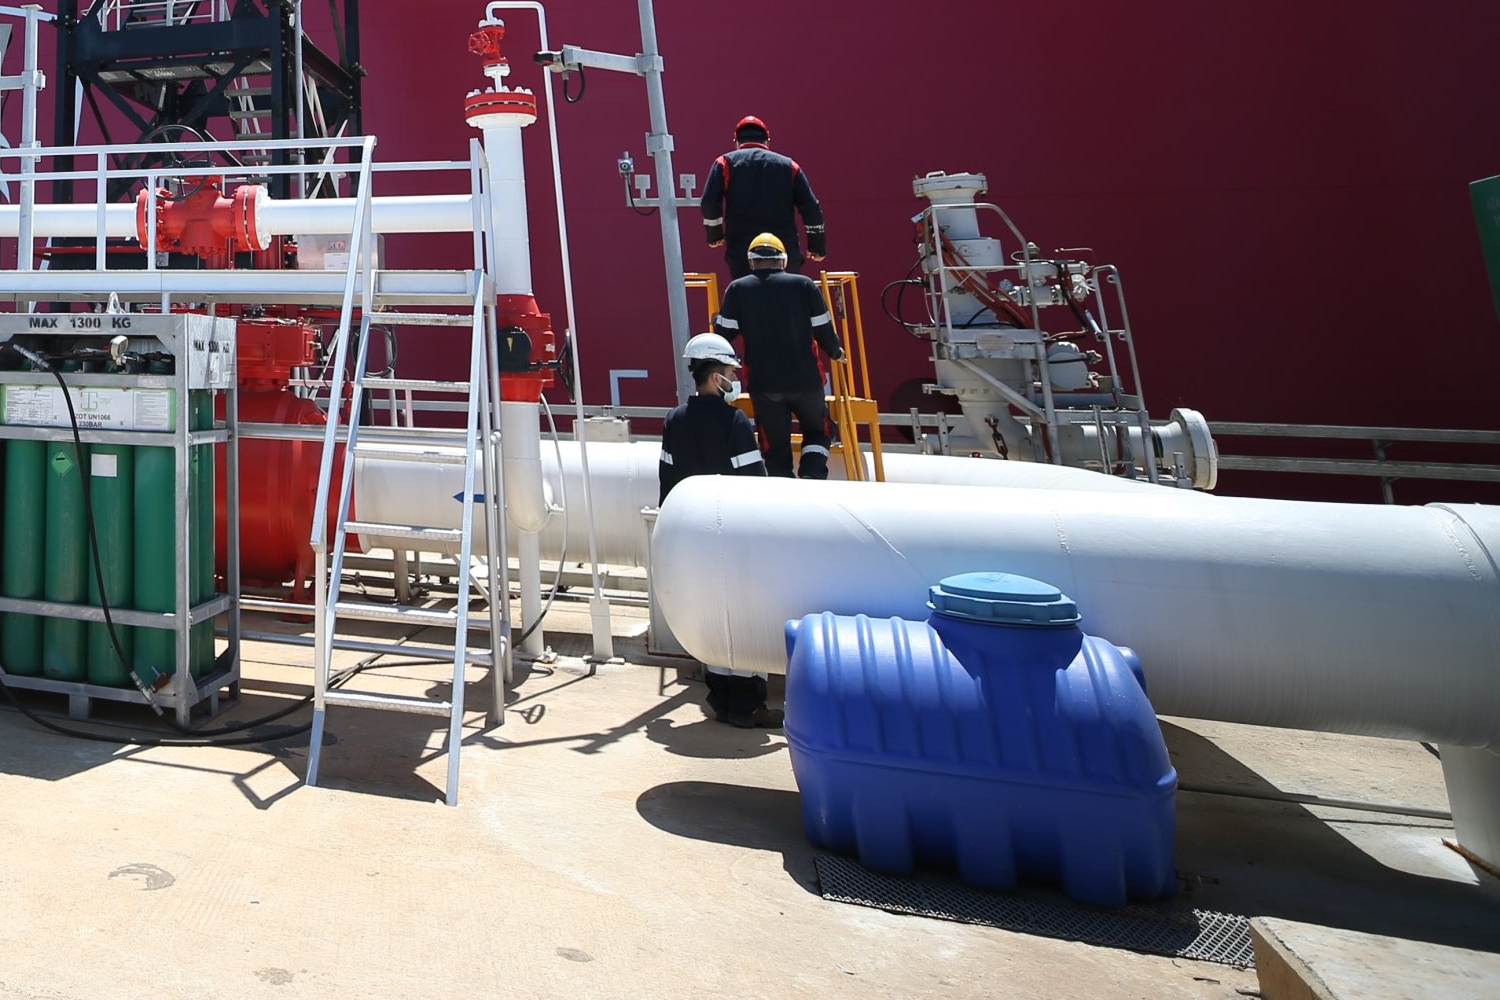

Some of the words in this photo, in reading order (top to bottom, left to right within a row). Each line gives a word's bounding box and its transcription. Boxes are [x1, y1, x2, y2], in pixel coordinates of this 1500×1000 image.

[29, 317, 58, 329] MAX
[69, 317, 101, 329] 1300
[112, 317, 131, 329] KG
